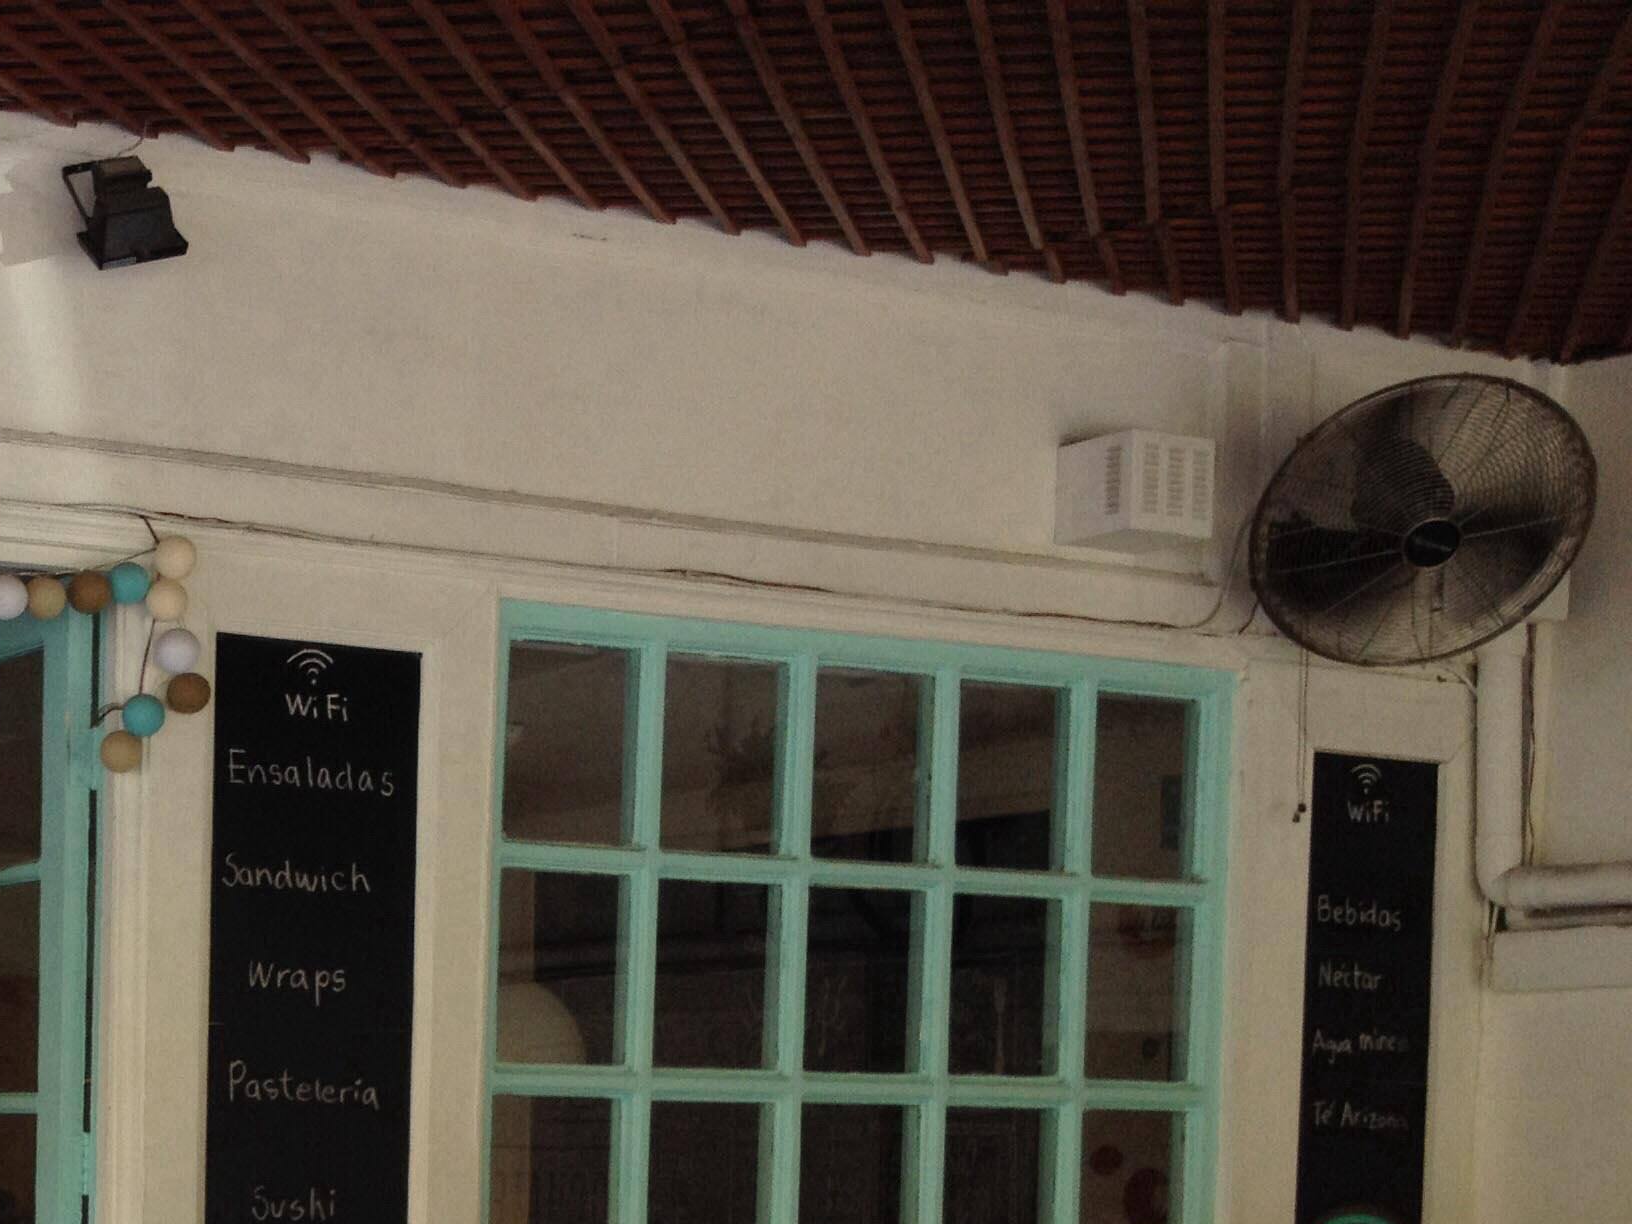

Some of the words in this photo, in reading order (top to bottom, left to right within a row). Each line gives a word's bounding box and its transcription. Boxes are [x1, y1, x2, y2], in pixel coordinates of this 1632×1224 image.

[228, 748, 395, 798] Ensaladas
[222, 851, 372, 893] Sandwich
[1317, 894, 1402, 933] Bebidas
[248, 960, 347, 1007] Wraps
[251, 1184, 337, 1222] Sushi
